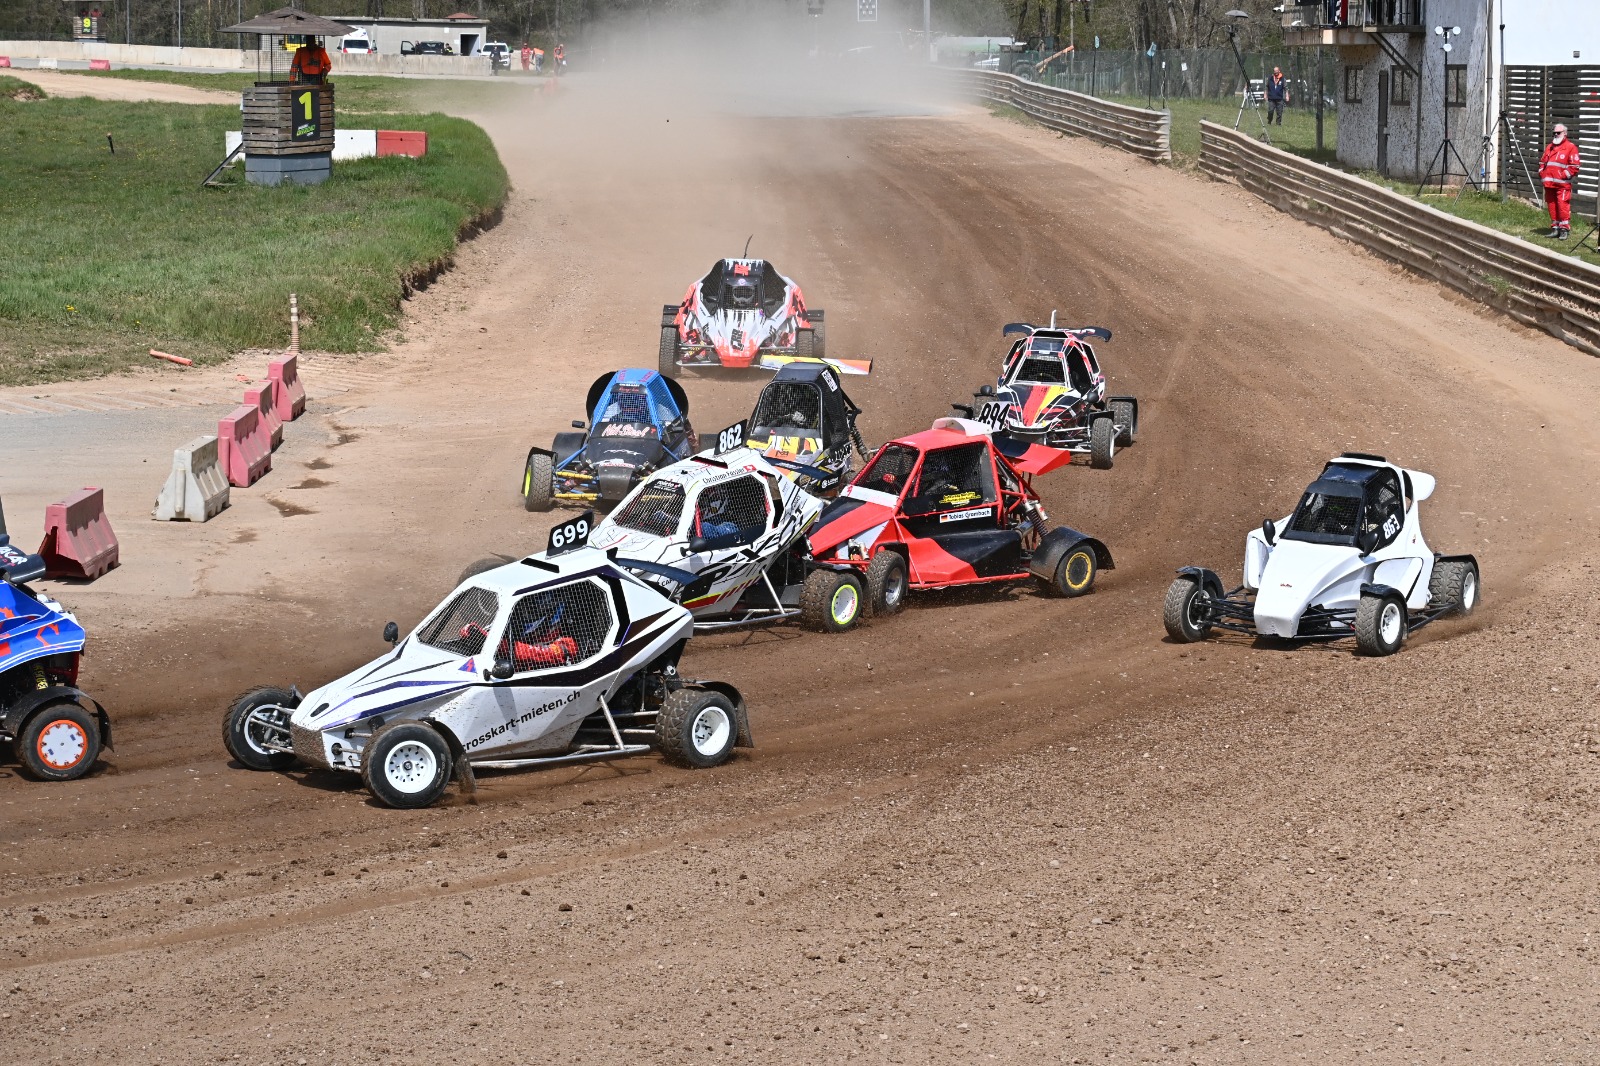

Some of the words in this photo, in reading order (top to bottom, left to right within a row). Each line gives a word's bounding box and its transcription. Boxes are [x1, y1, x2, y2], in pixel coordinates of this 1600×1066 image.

[299, 91, 313, 120] 1
[978, 402, 1011, 431] 894
[719, 423, 742, 453] 862
[552, 519, 589, 548] 699
[1382, 513, 1401, 540] 863
